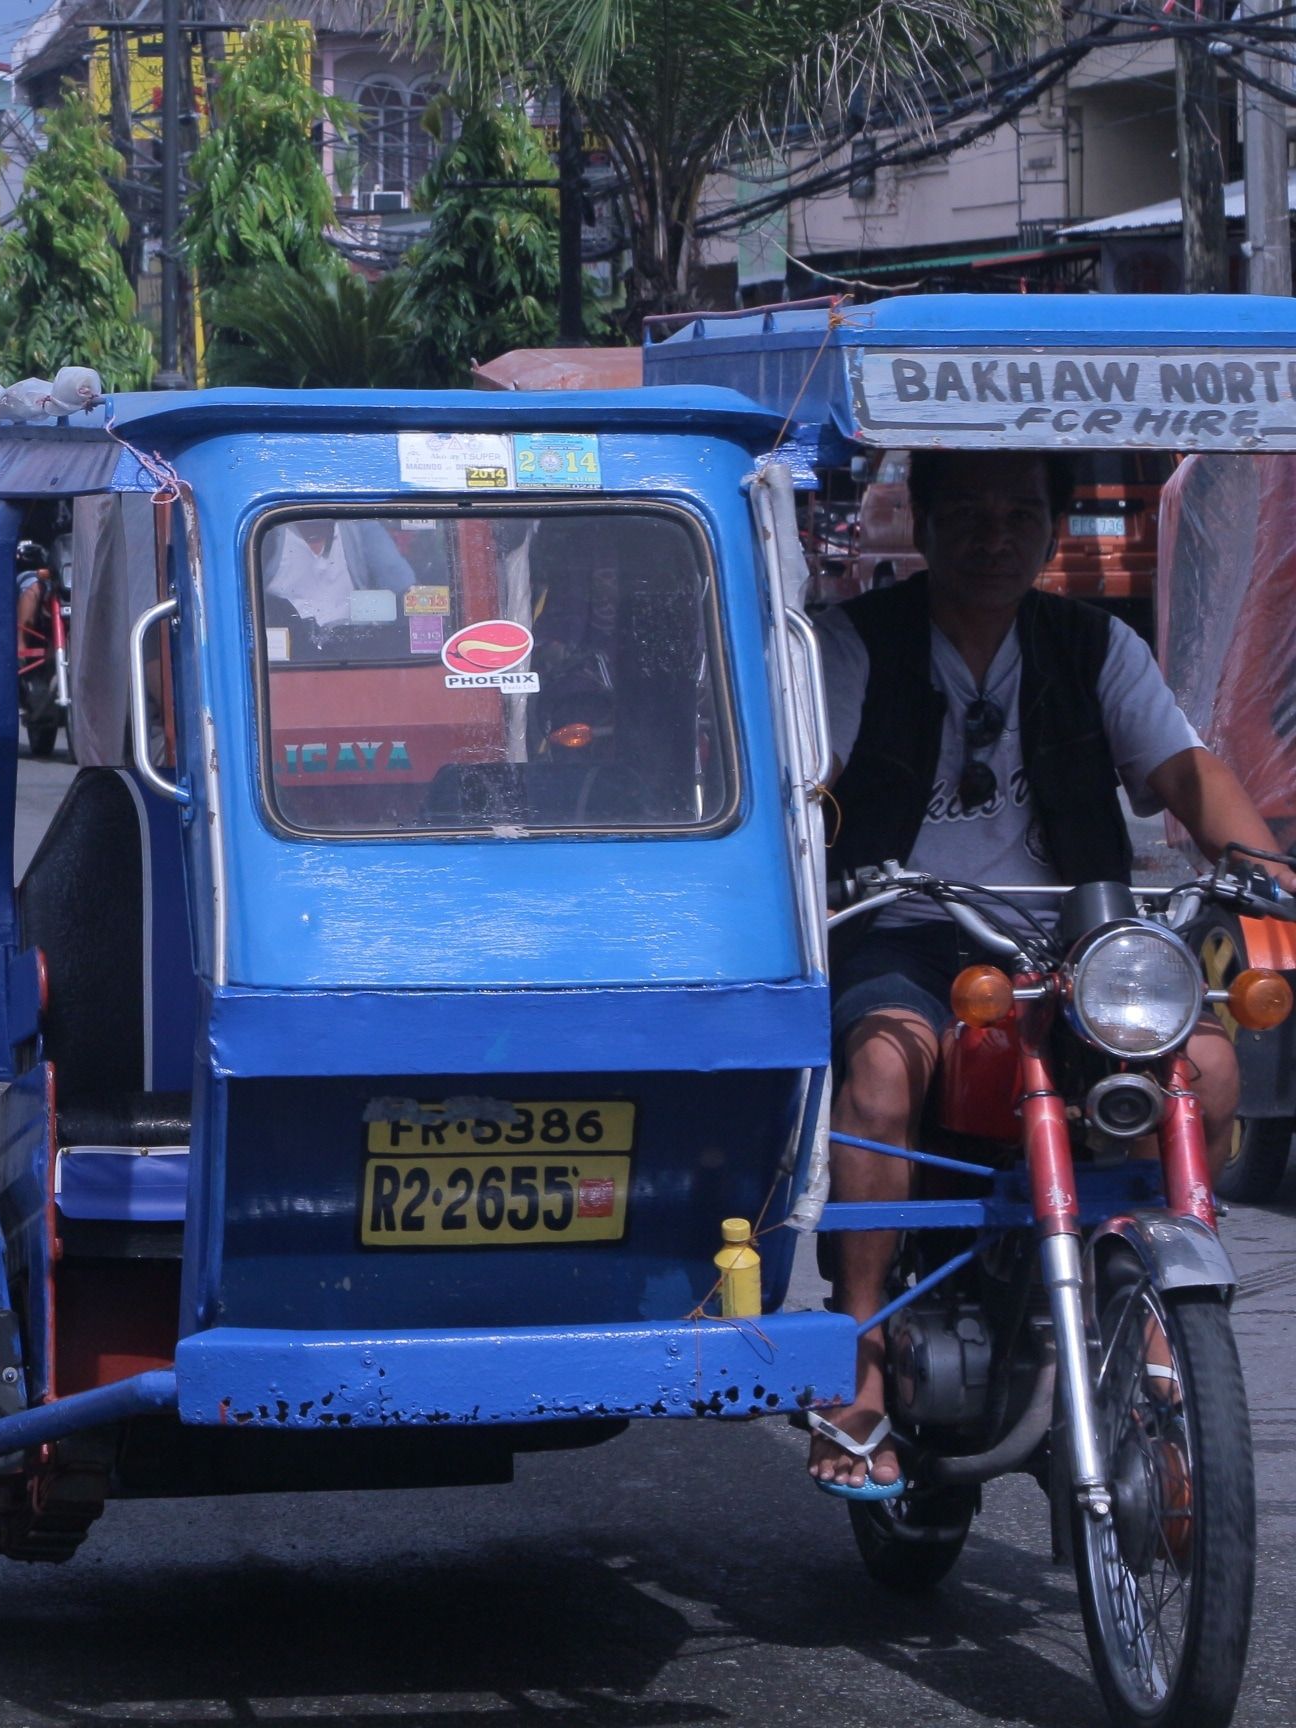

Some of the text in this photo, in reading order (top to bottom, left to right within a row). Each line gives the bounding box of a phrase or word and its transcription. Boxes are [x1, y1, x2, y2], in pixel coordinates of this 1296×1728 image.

[891, 358, 1140, 403] BAKHAW
[1133, 407, 1260, 437] HIRE
[471, 469, 506, 479] 2014
[448, 674, 535, 687] PHOENIX
